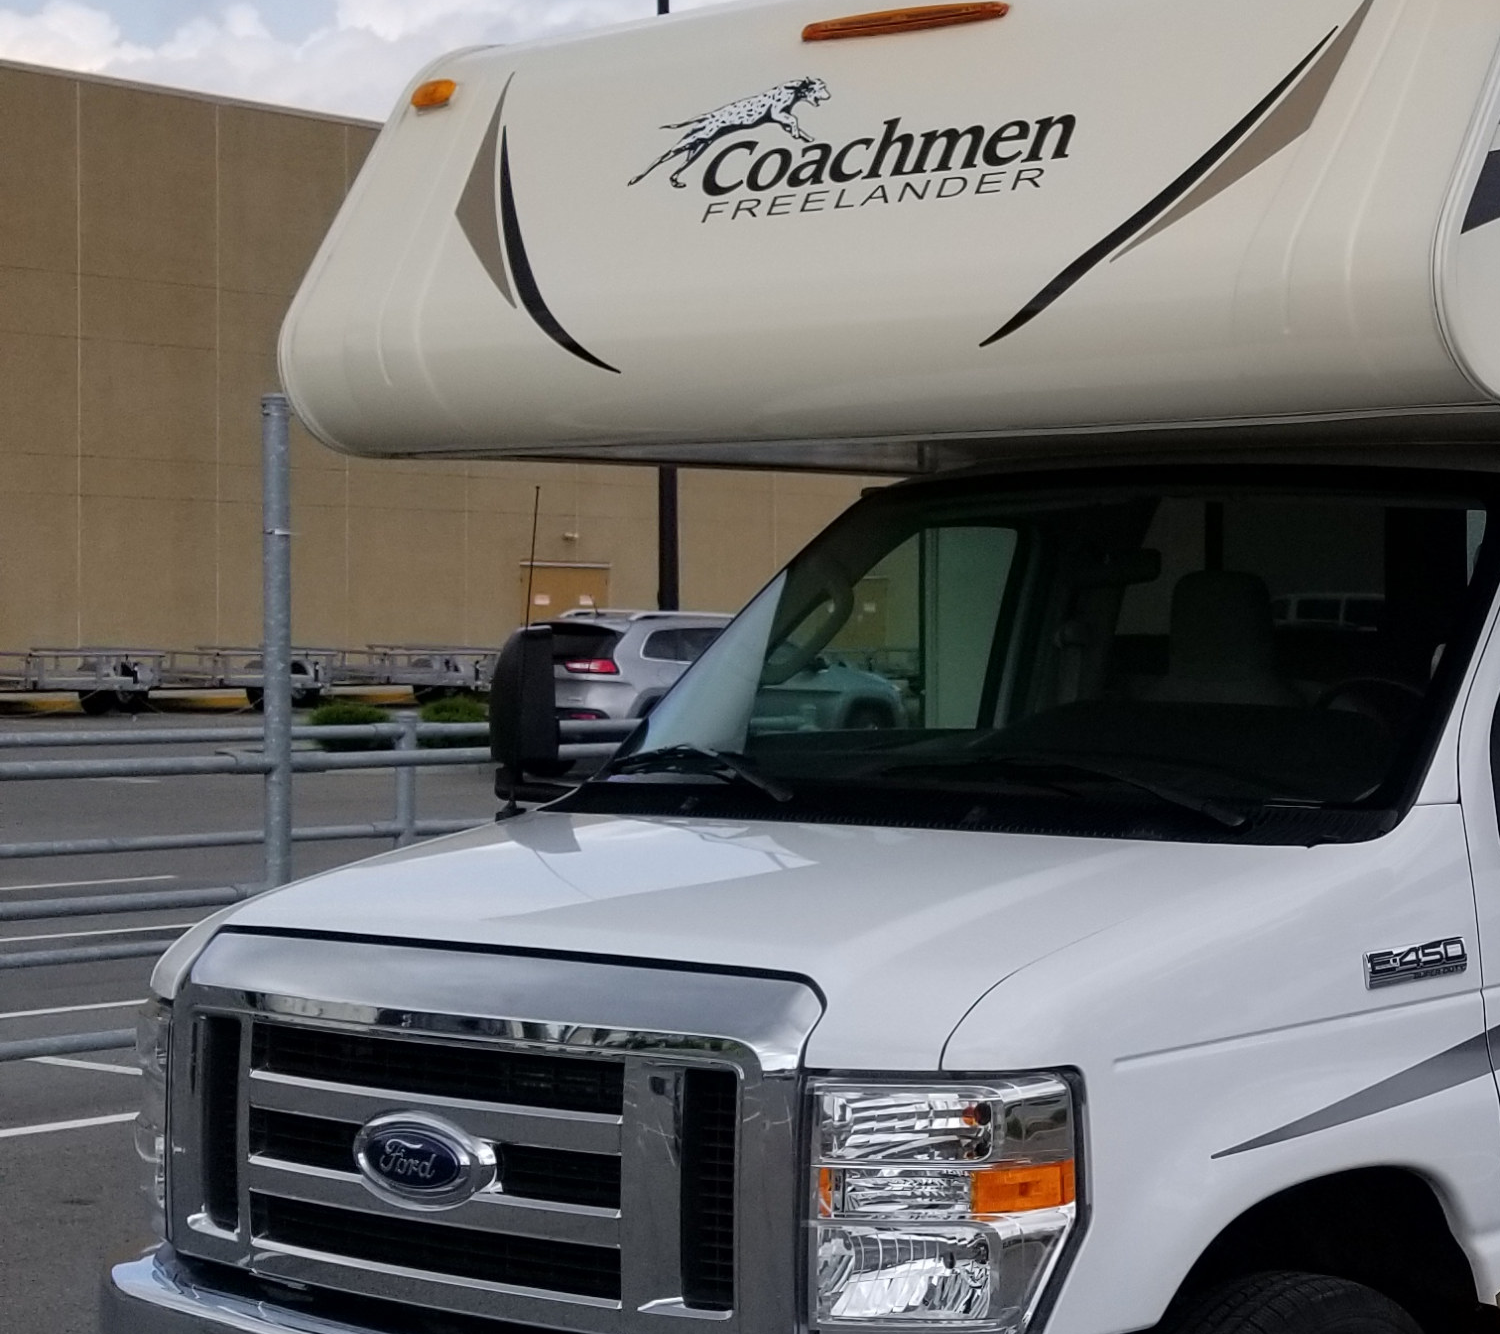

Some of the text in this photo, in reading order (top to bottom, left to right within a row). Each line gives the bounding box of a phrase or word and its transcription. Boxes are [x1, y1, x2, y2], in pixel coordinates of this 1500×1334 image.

[702, 114, 1076, 196] Coachmen
[700, 168, 1046, 223] FREELANDER
[1367, 938, 1466, 975] E-450
[379, 1138, 437, 1178] Ford
